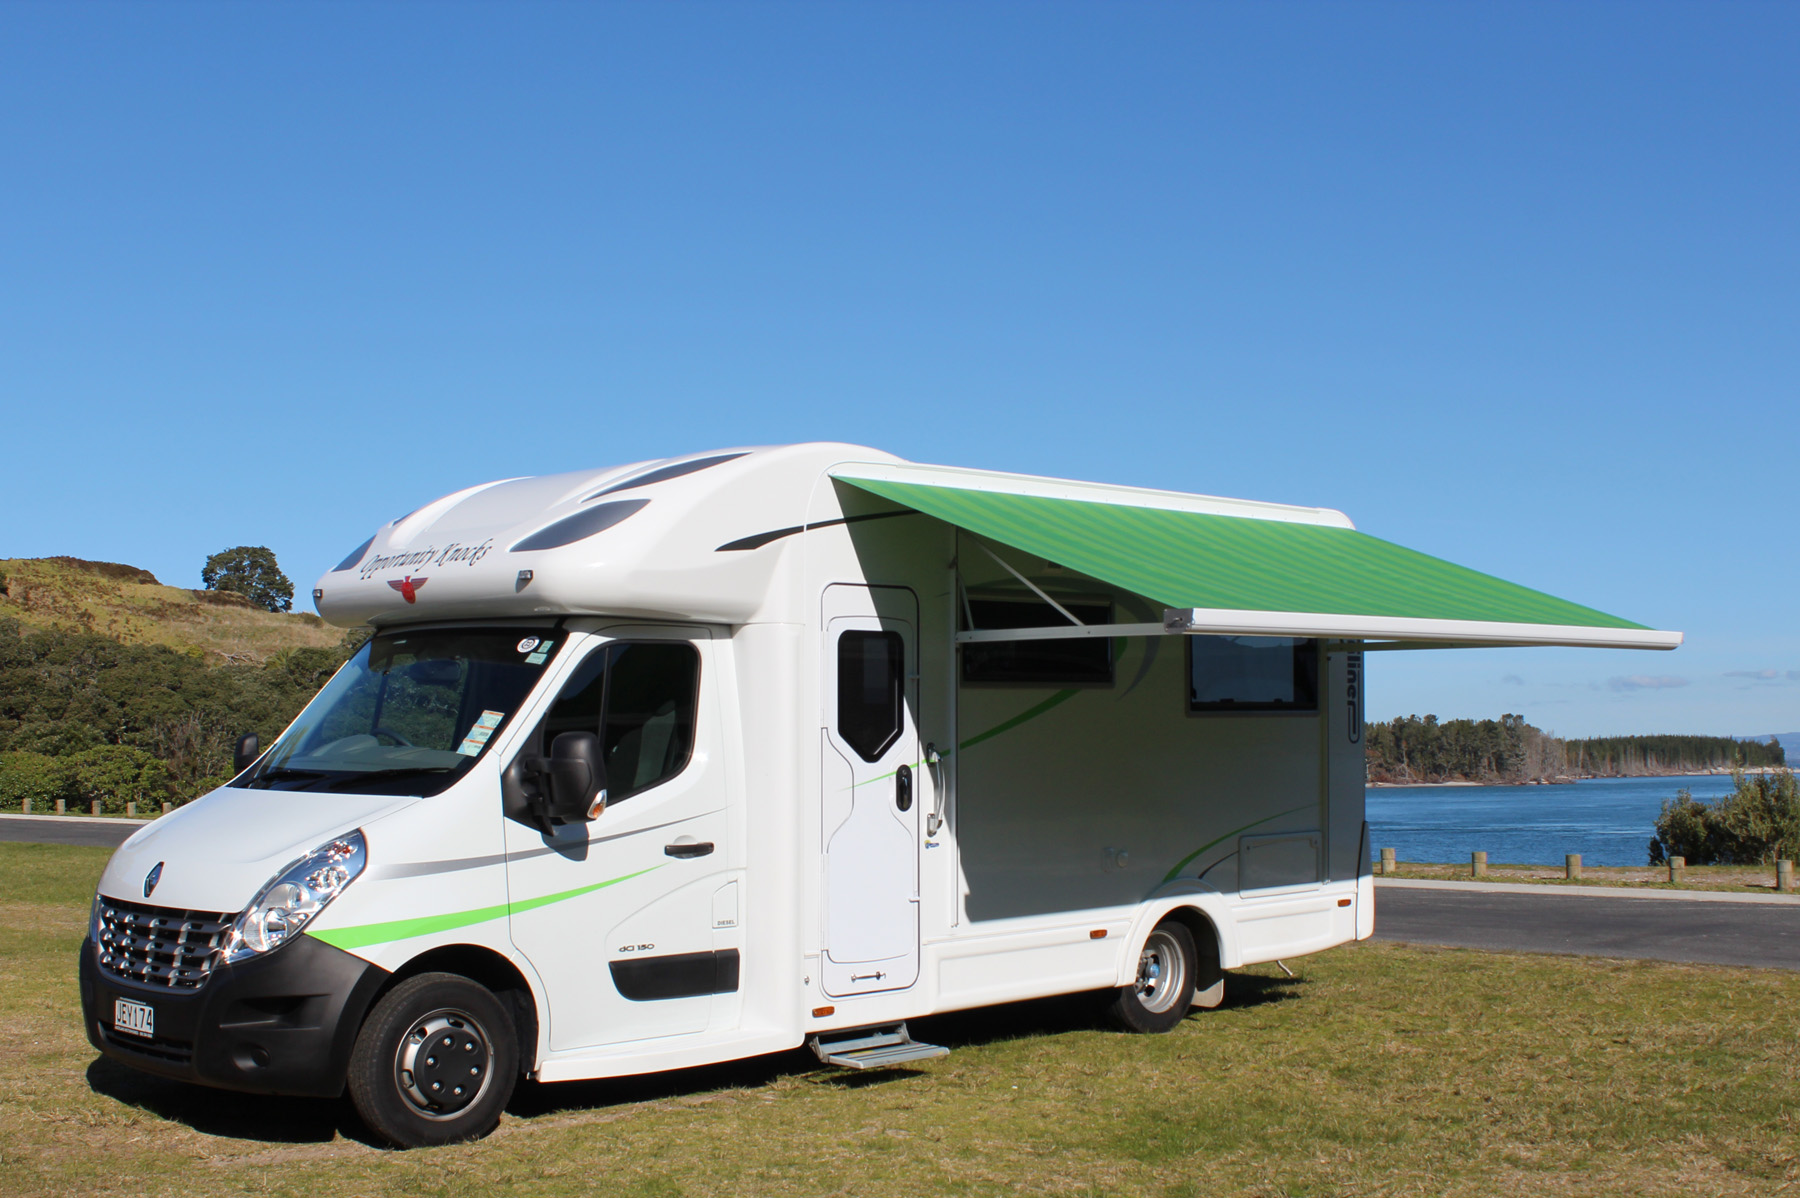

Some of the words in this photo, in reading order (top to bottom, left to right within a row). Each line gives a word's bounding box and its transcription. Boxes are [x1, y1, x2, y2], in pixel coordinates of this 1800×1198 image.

[360, 545, 439, 580] Opportunity
[434, 538, 494, 567] Knocks
[637, 943, 655, 951] 150
[116, 1002, 153, 1030] JEY174
